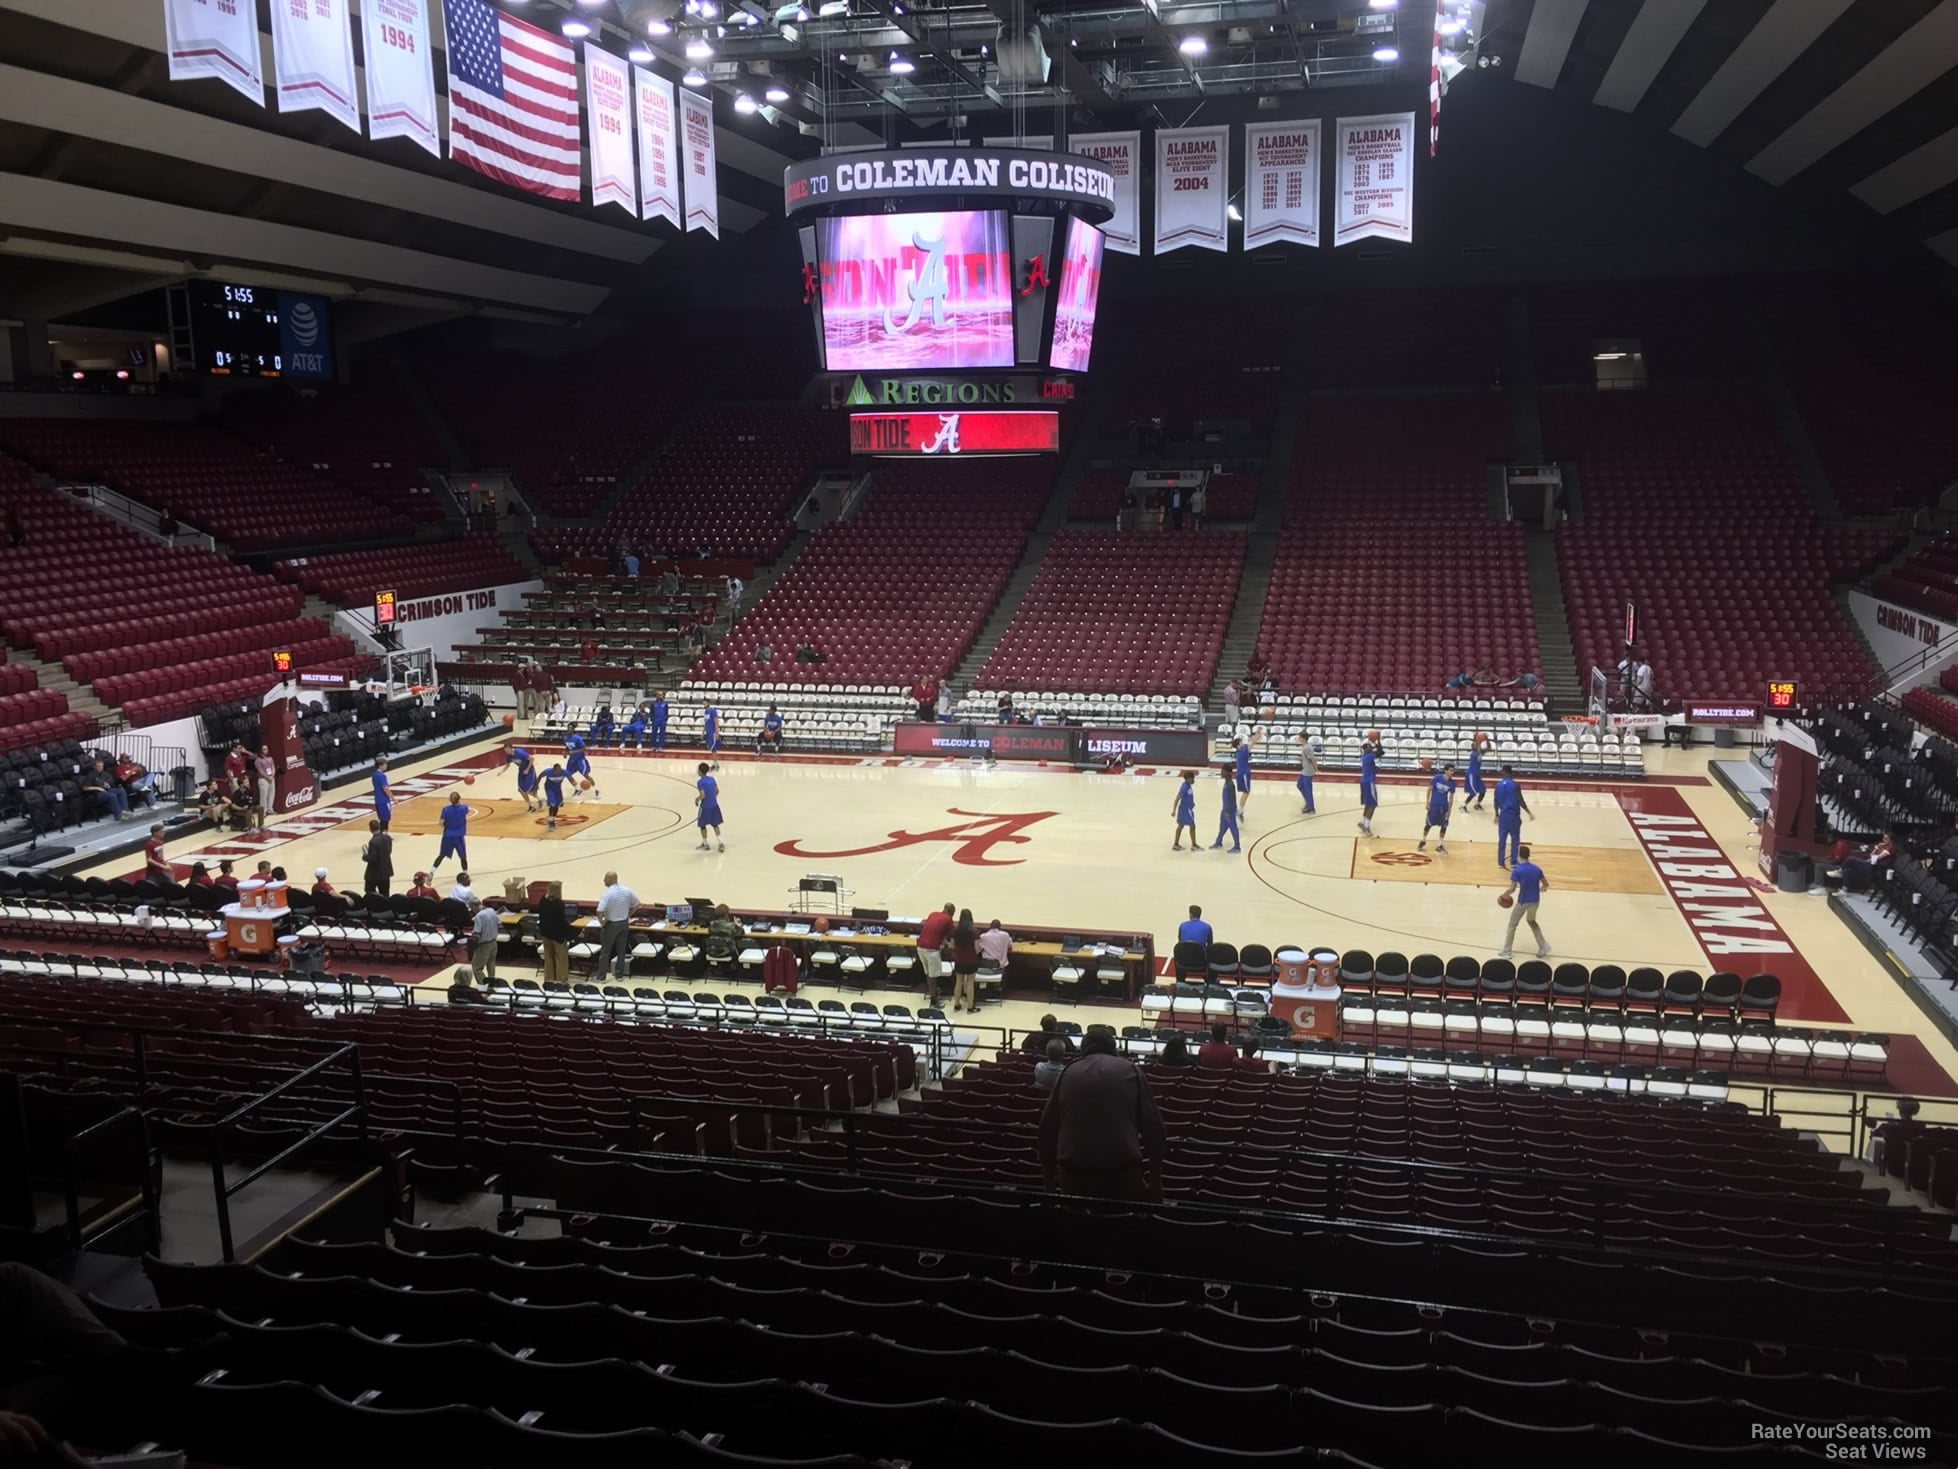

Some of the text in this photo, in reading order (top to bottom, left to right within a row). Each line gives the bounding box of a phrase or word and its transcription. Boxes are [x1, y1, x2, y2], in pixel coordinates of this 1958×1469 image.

[380, 23, 415, 54] 1994
[592, 65, 623, 92] ALABAMA
[642, 87, 668, 112] ALABAMA
[599, 113, 622, 135] 1994
[686, 106, 709, 129] ALABAMA
[1257, 134, 1309, 150] ALABAMA
[1348, 128, 1401, 144] ALABAMA
[1081, 146, 1129, 159] ALABAMA
[1167, 141, 1217, 155] ALABAMA
[1259, 159, 1306, 167] APPEARANCES
[810, 175, 829, 195] TO
[836, 158, 1001, 193] COLEMAN
[1009, 160, 1115, 202] COLISEUM
[1173, 177, 1209, 191] 2004
[1354, 193, 1393, 201] CHAMPIONS
[292, 353, 324, 372] AT&T
[880, 380, 1016, 404] REGIONS
[874, 419, 911, 449] TIDE
[397, 590, 496, 623] CRIMSON TIDE
[1877, 604, 1940, 648] CRIMSON TIDE
[277, 661, 289, 670] 30
[1770, 684, 1794, 693] 51:55
[1774, 694, 1790, 705] 30
[1692, 708, 1754, 718] ROLLTIDE.COM
[931, 736, 1065, 750] WELCOME TO COLEMAN
[1087, 739, 1147, 754] LISEUM
[1628, 812, 1795, 955] ALABAMA
[240, 923, 257, 944] G
[1293, 1005, 1315, 1029] G
